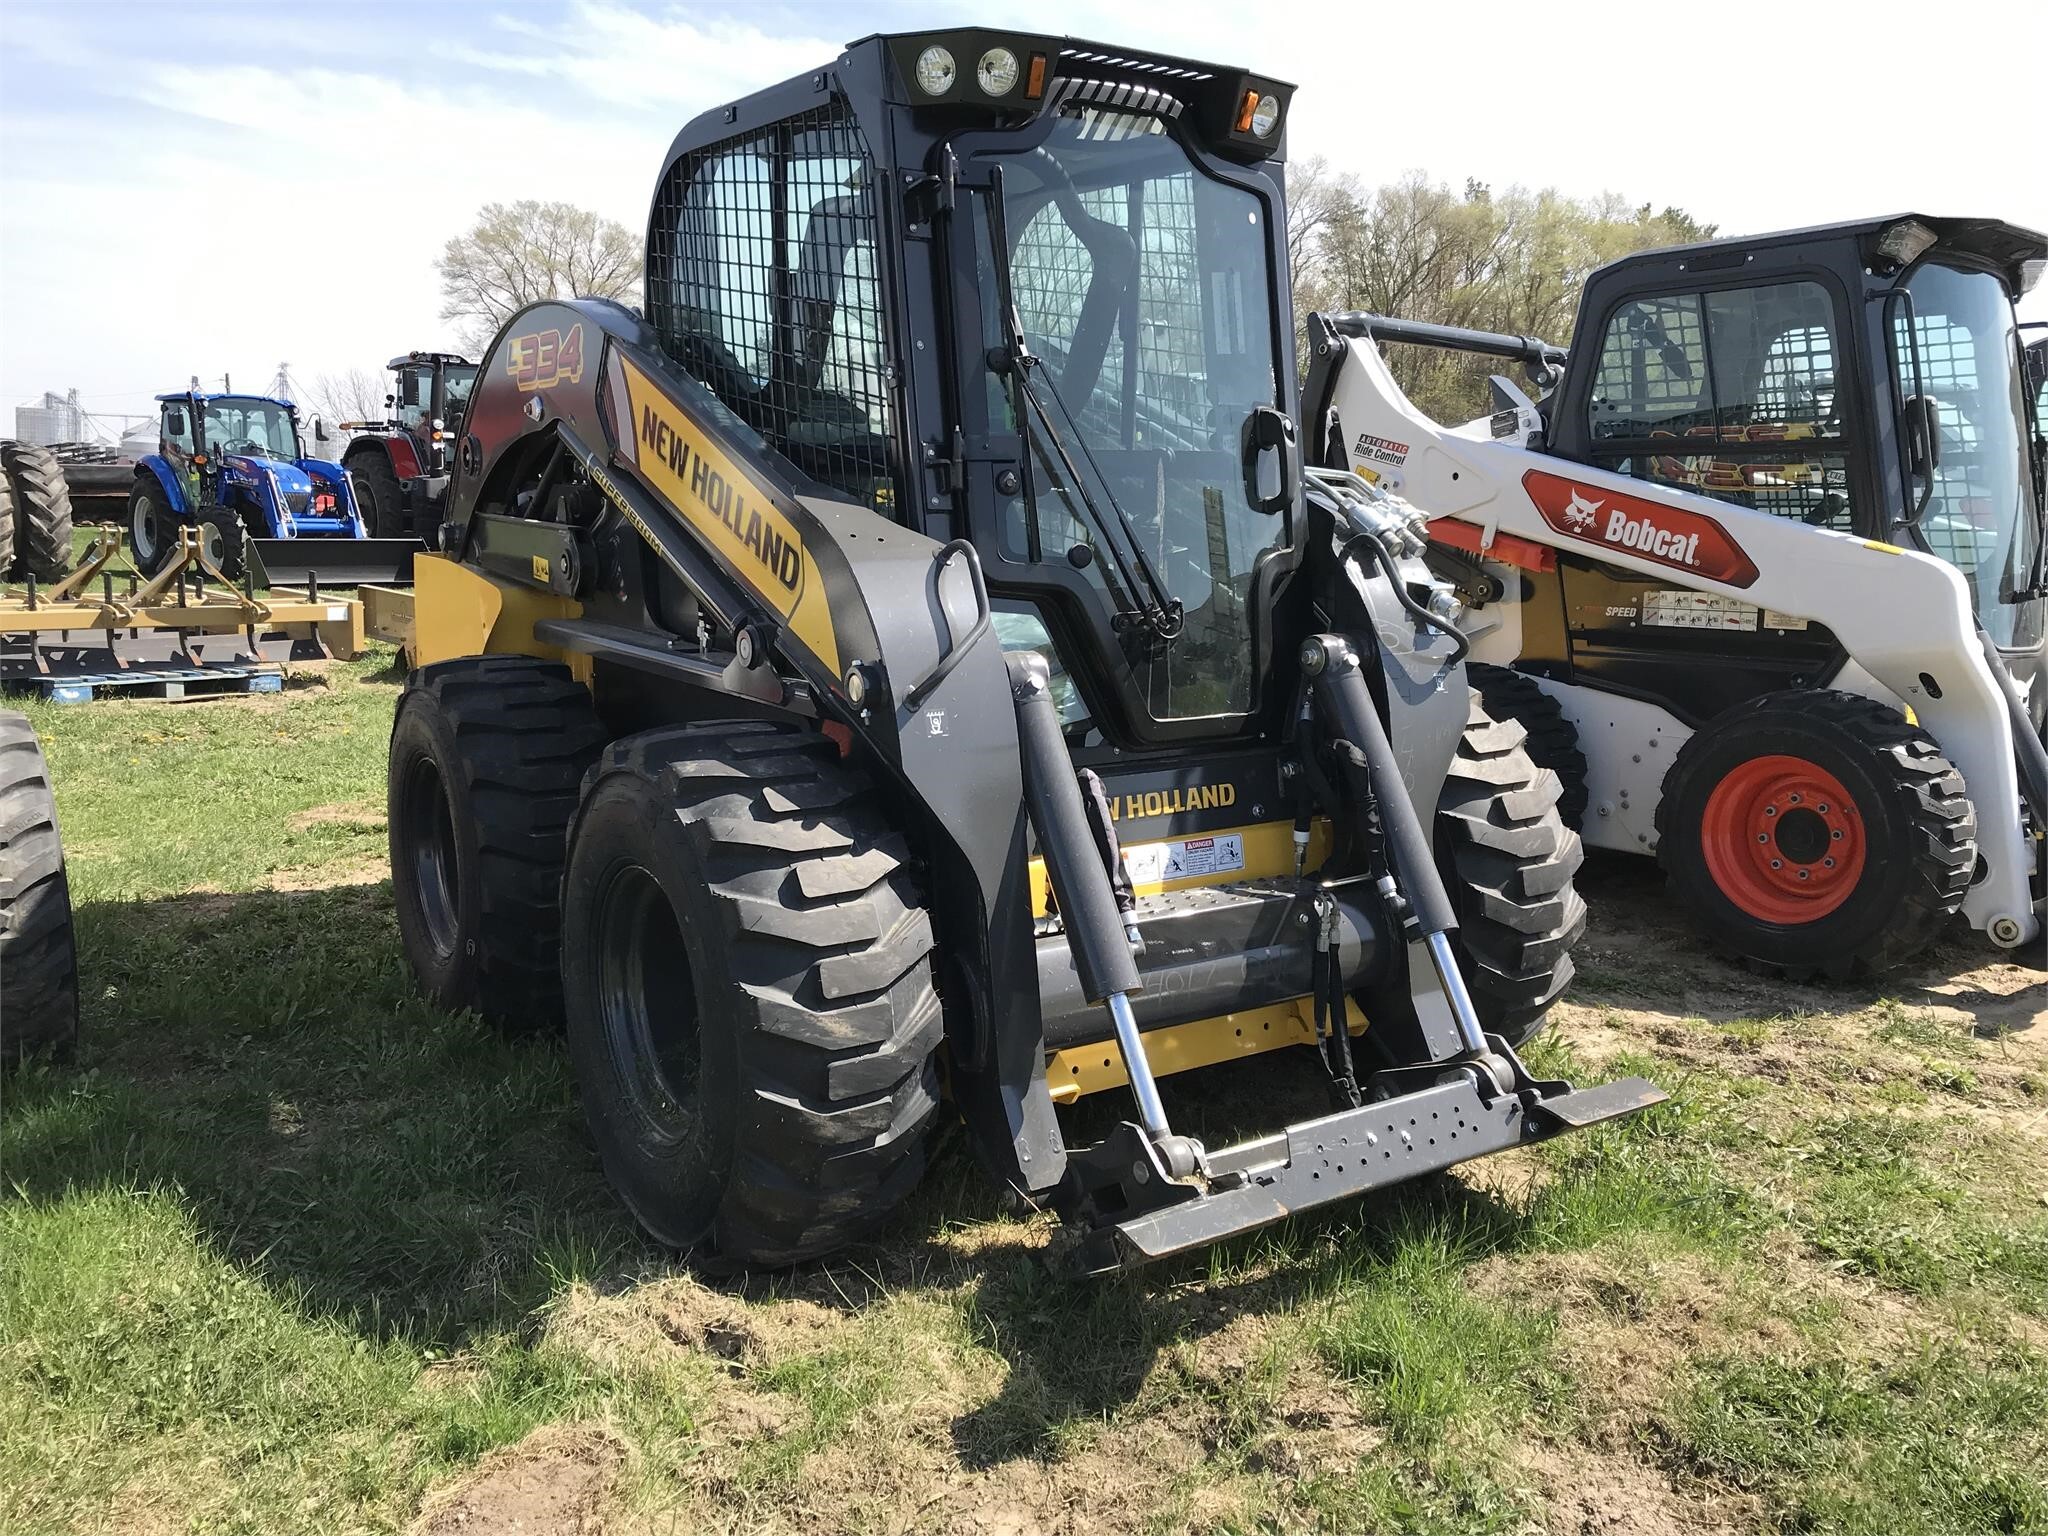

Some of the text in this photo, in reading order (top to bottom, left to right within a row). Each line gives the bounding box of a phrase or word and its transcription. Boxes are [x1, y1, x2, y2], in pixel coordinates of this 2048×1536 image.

[1354, 443, 1406, 466] Ride Control
[1360, 435, 1408, 454] AUTOMATIC
[641, 404, 800, 592] NEW HOLLAND
[1605, 510, 1699, 565] Bobcat
[1605, 606, 1637, 618] SPEED
[1126, 783, 1235, 819] HOLLAND
[1192, 840, 1213, 849] DANGER
